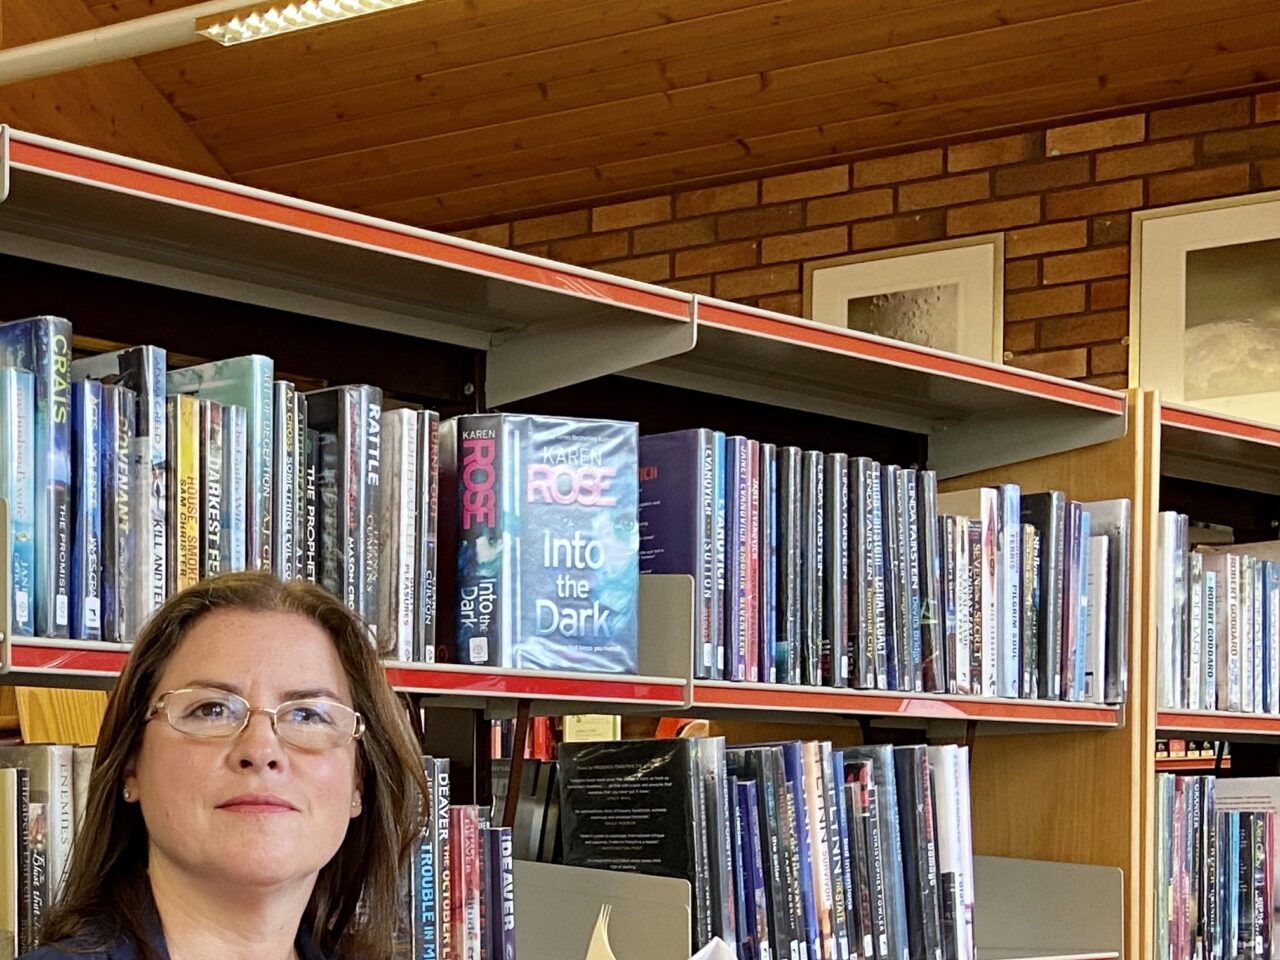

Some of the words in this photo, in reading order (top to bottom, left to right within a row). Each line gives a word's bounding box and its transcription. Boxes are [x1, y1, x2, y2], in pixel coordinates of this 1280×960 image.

[51, 334, 67, 424] CRAIS
[368, 403, 381, 486] RATTLE
[462, 430, 495, 439] KAREN
[542, 446, 603, 466] KAREN
[306, 465, 315, 500] THE
[462, 440, 495, 530] ROSE
[527, 465, 617, 506] ROSE
[58, 503, 67, 525] THE
[59, 531, 67, 595] PROMISE
[306, 506, 316, 582] PROPHET
[543, 530, 606, 569] Into
[909, 524, 918, 588] FAIRSTEIN
[556, 574, 590, 599] the
[536, 599, 610, 638] Dark
[438, 773, 449, 840] DEAVER
[442, 845, 450, 868] THE
[421, 842, 434, 923] TROUBLE
[442, 870, 450, 941] OCTOBER
[423, 926, 434, 941] IN
